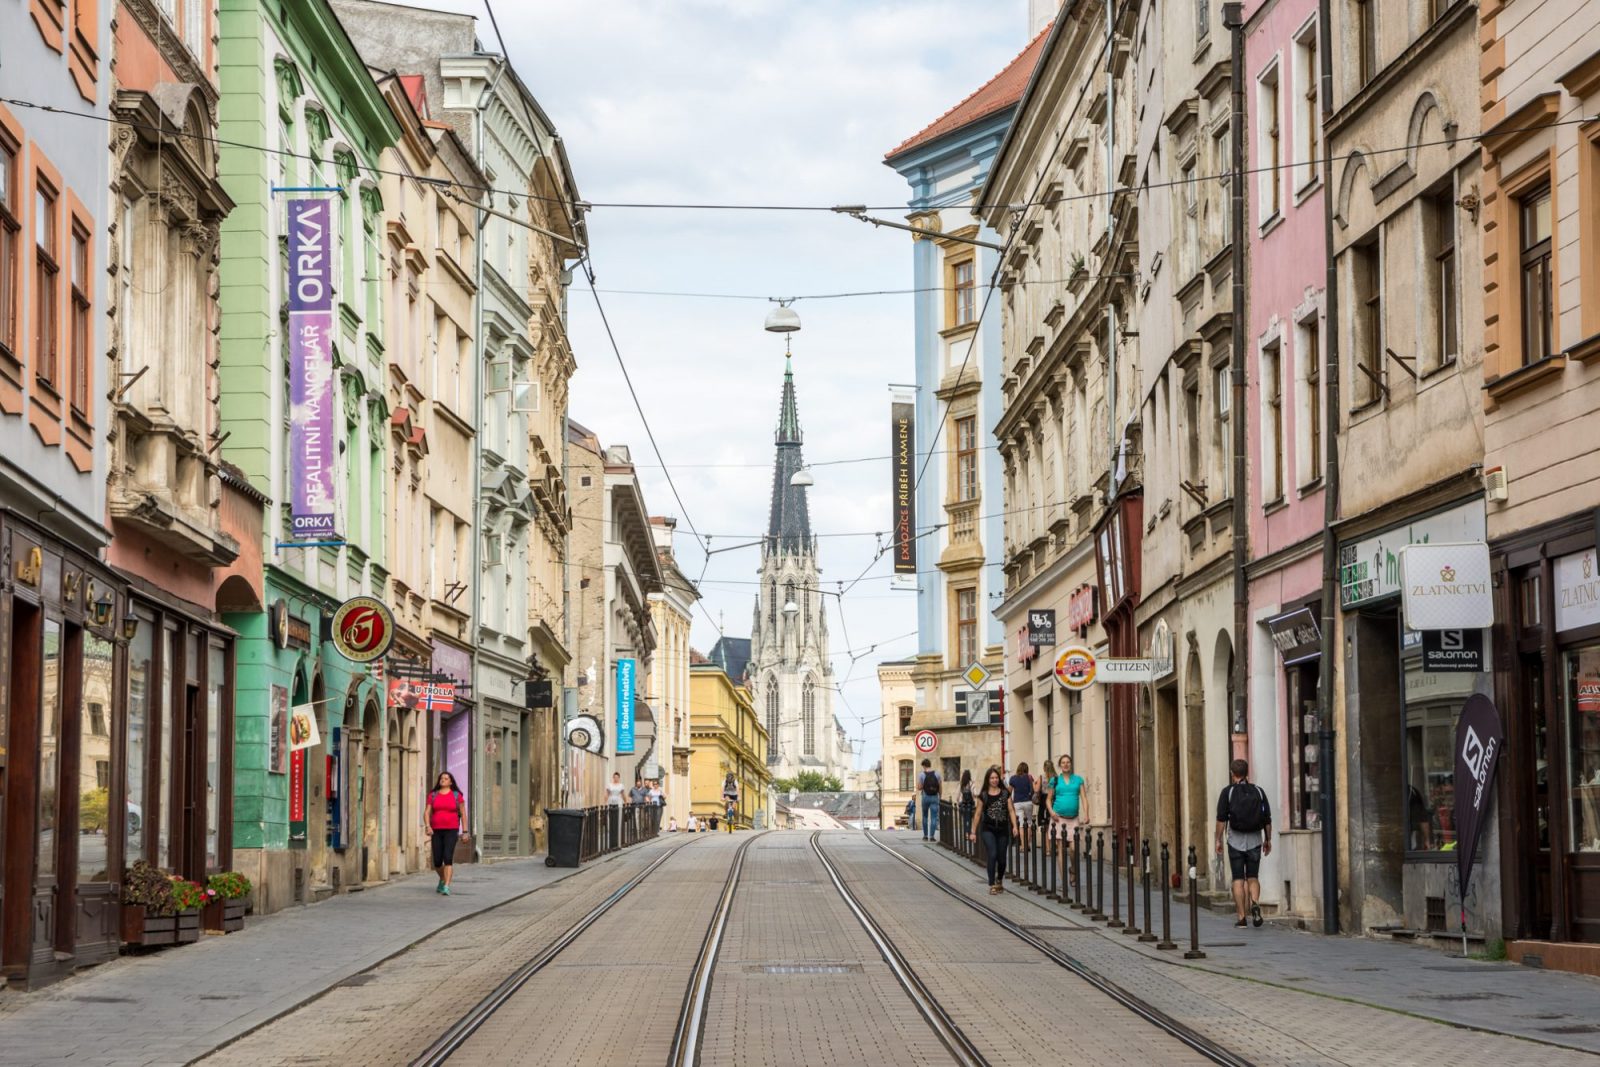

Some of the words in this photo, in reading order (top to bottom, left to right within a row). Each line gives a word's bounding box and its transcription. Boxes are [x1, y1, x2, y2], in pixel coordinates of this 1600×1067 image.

[300, 325, 321, 421] KANCELÁŘ
[899, 418, 908, 465] KAMENE
[302, 426, 321, 507] REALITNÍ
[295, 516, 332, 528] ORKA
[1412, 581, 1487, 597] ZLATNICTVÍ
[1427, 650, 1478, 660] salomon
[1105, 662, 1151, 672] CITIZEN
[424, 685, 455, 697] TROLLA
[920, 736, 933, 747] 20
[1473, 736, 1497, 812] salomon
